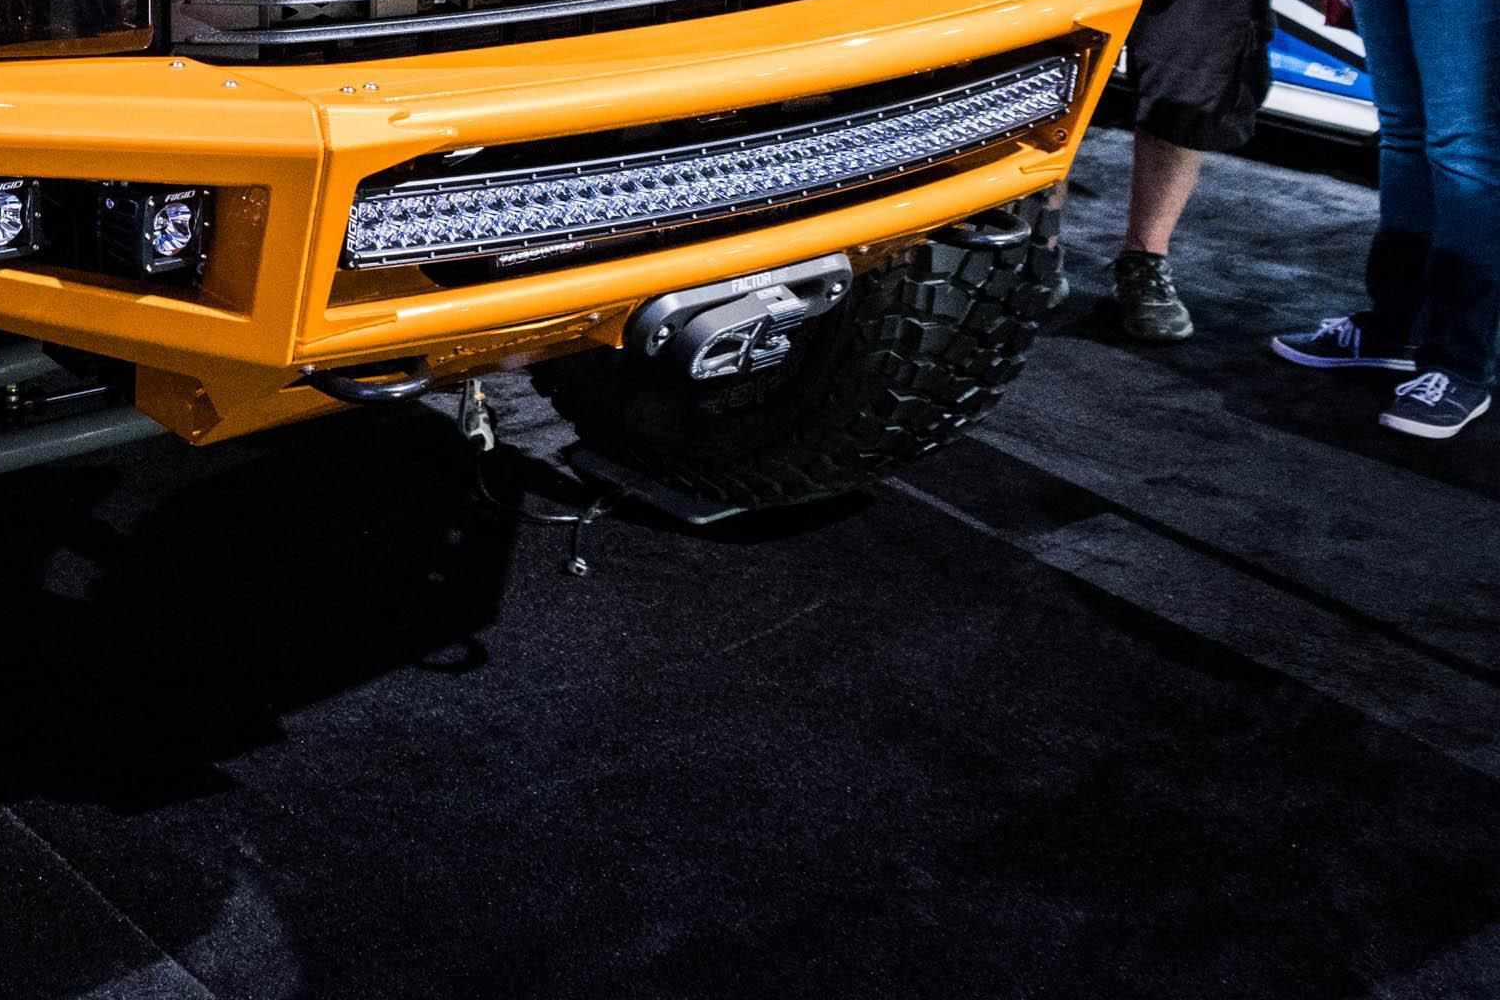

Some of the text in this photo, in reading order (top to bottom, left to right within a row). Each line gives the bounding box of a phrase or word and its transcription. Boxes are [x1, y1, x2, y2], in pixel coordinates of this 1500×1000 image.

[164, 189, 196, 203] RIGID
[346, 205, 358, 253] RIGID
[731, 272, 772, 293] FACTOR
